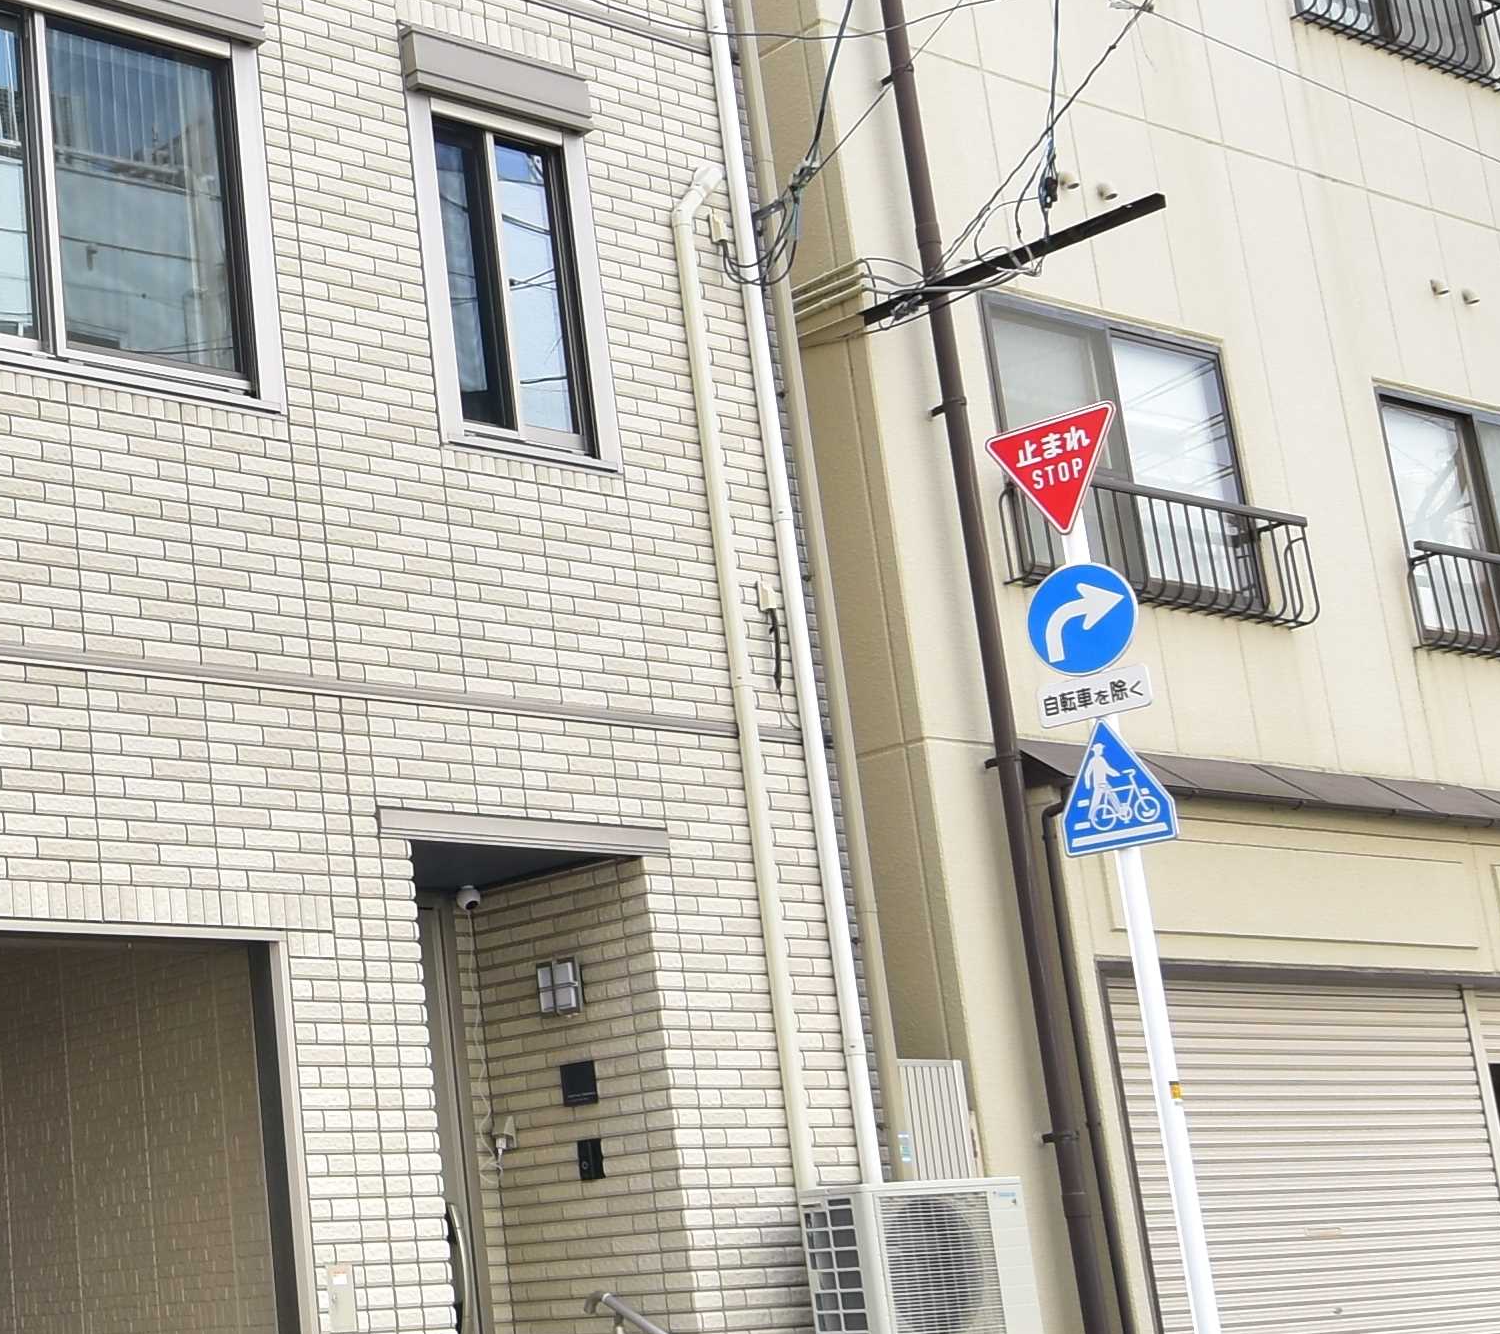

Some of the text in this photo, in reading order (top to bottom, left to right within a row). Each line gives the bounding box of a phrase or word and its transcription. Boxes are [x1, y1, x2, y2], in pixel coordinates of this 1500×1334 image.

[1016, 426, 1091, 468] 止まれ
[1032, 457, 1083, 490] STOP
[1043, 679, 1144, 717] 自転車を除く
